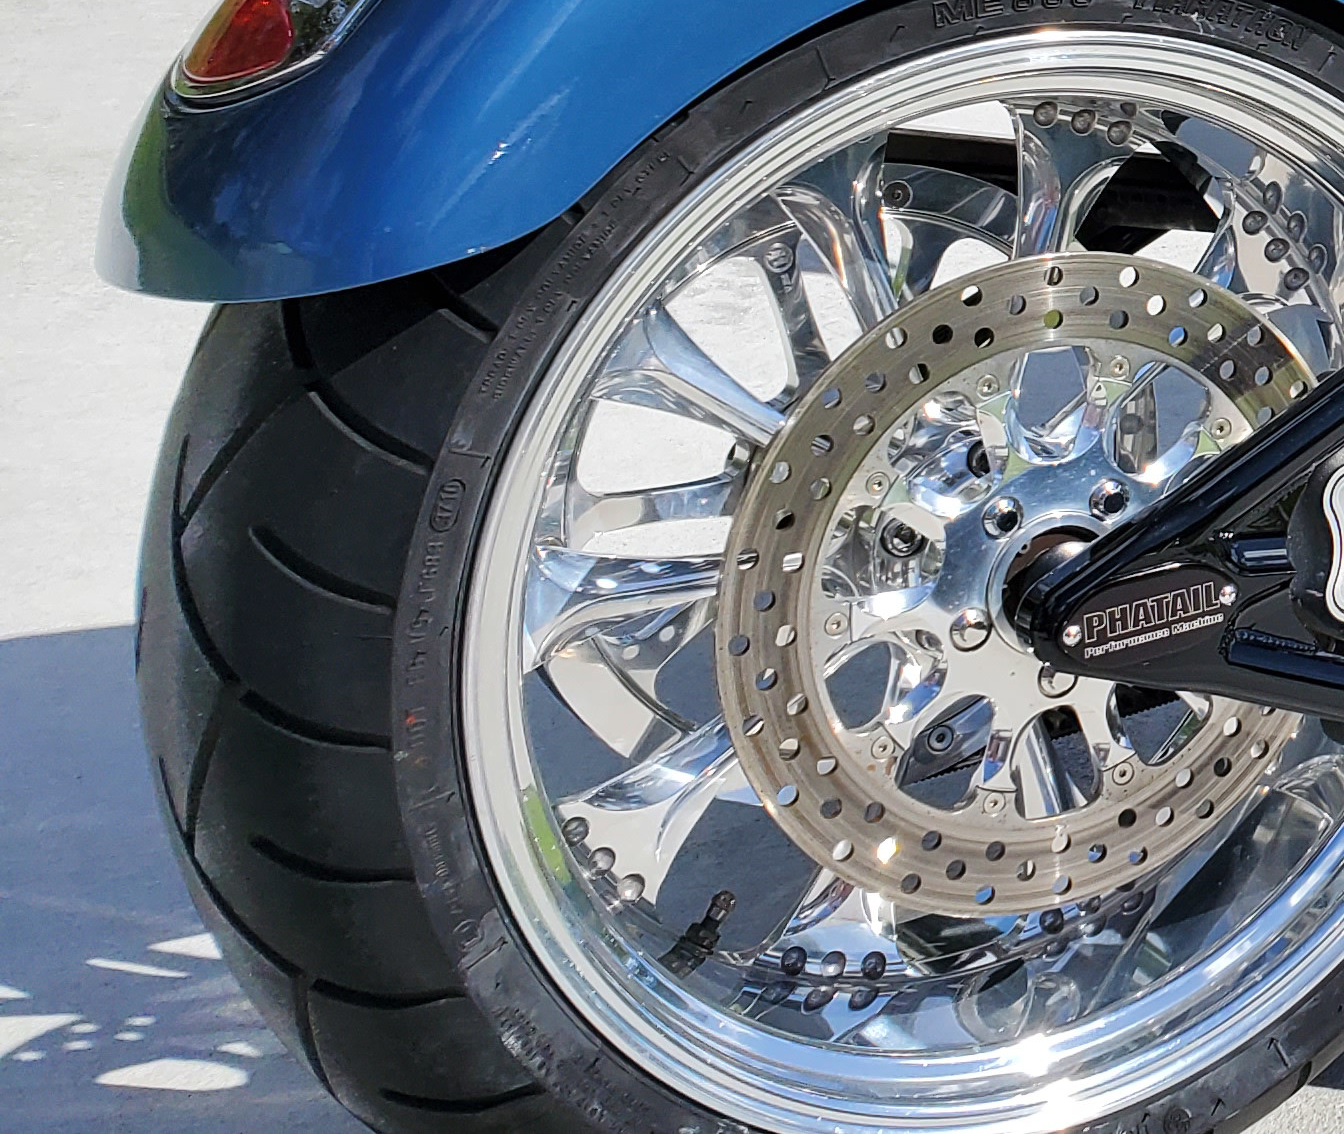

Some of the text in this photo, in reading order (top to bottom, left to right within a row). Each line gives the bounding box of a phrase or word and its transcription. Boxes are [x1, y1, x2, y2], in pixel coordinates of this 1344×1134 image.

[1084, 582, 1220, 643] PHATAIL
[1085, 613, 1223, 659] Performance Machine
